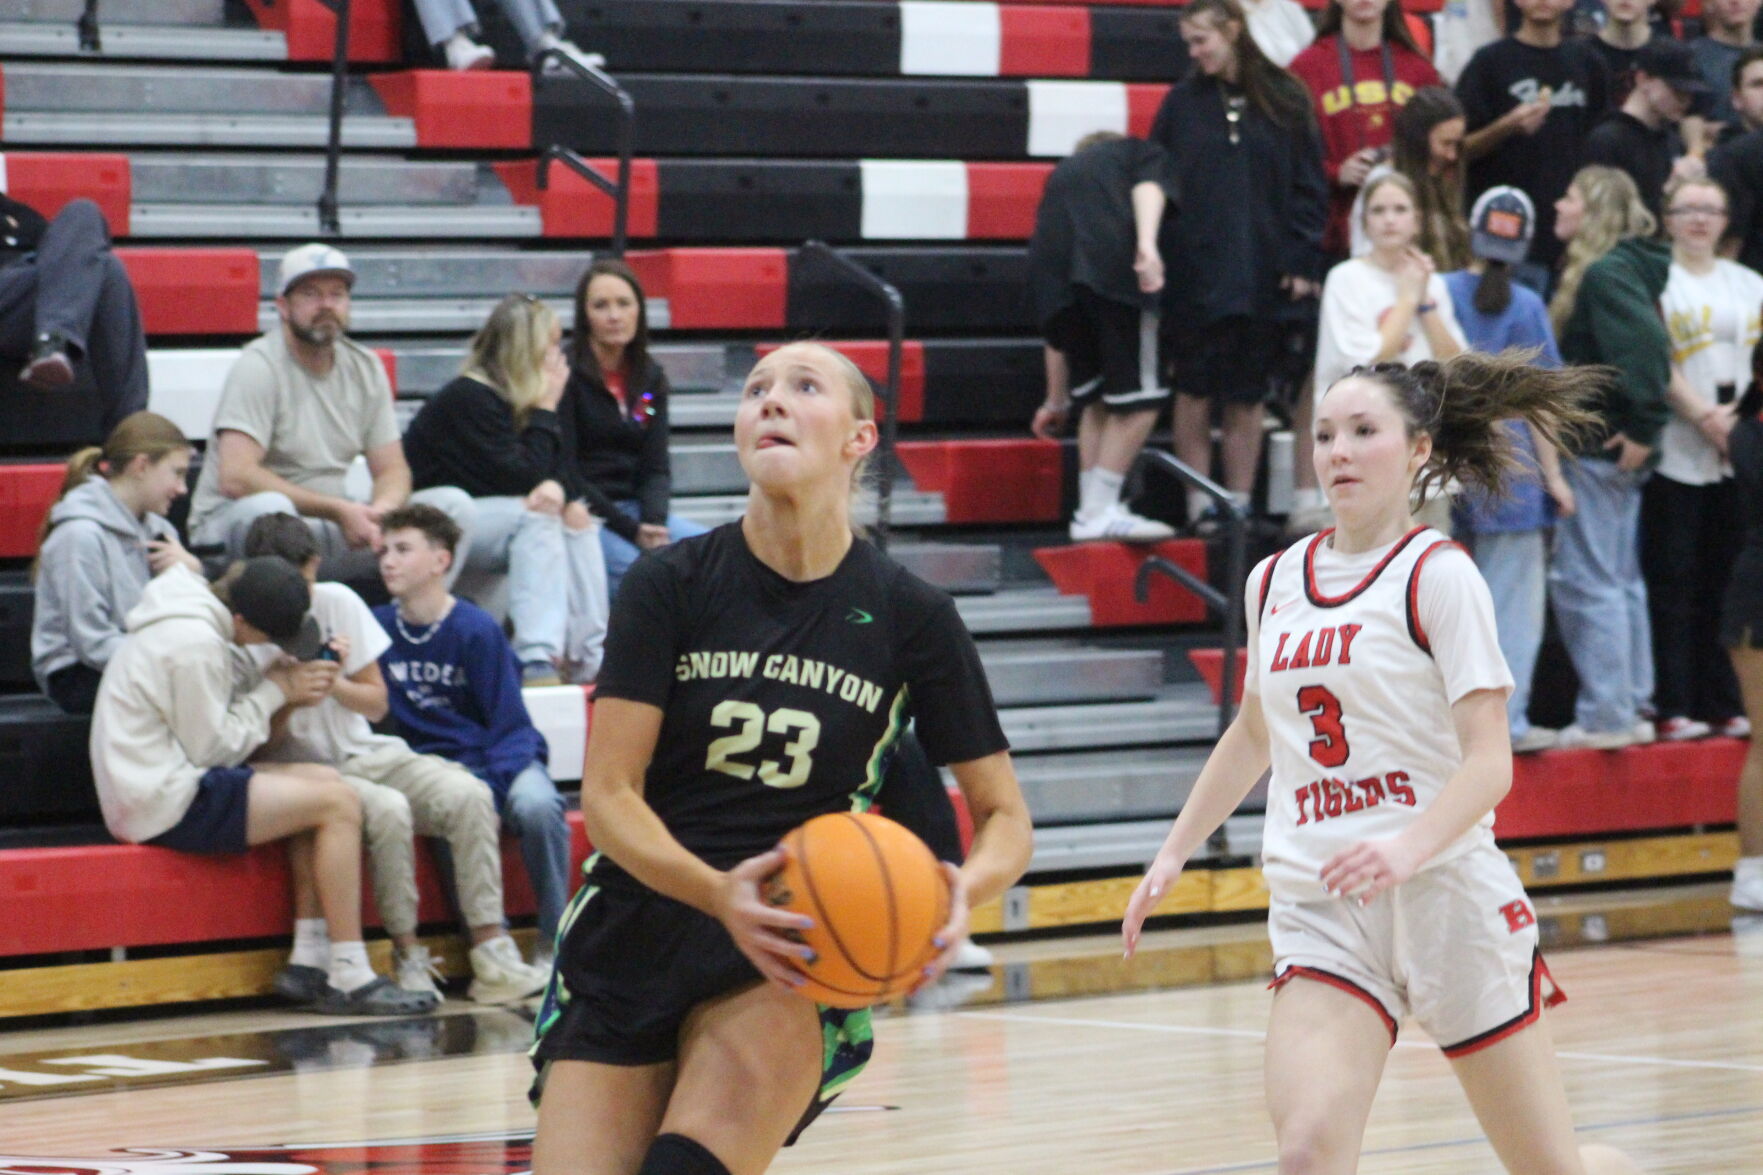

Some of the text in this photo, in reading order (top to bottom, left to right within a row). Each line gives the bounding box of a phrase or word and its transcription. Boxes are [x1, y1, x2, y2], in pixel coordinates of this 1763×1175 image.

[675, 651, 884, 713] SNOW CANYON
[1270, 623, 1363, 673] LADY
[705, 699, 822, 789] 23
[1297, 684, 1350, 769] 3
